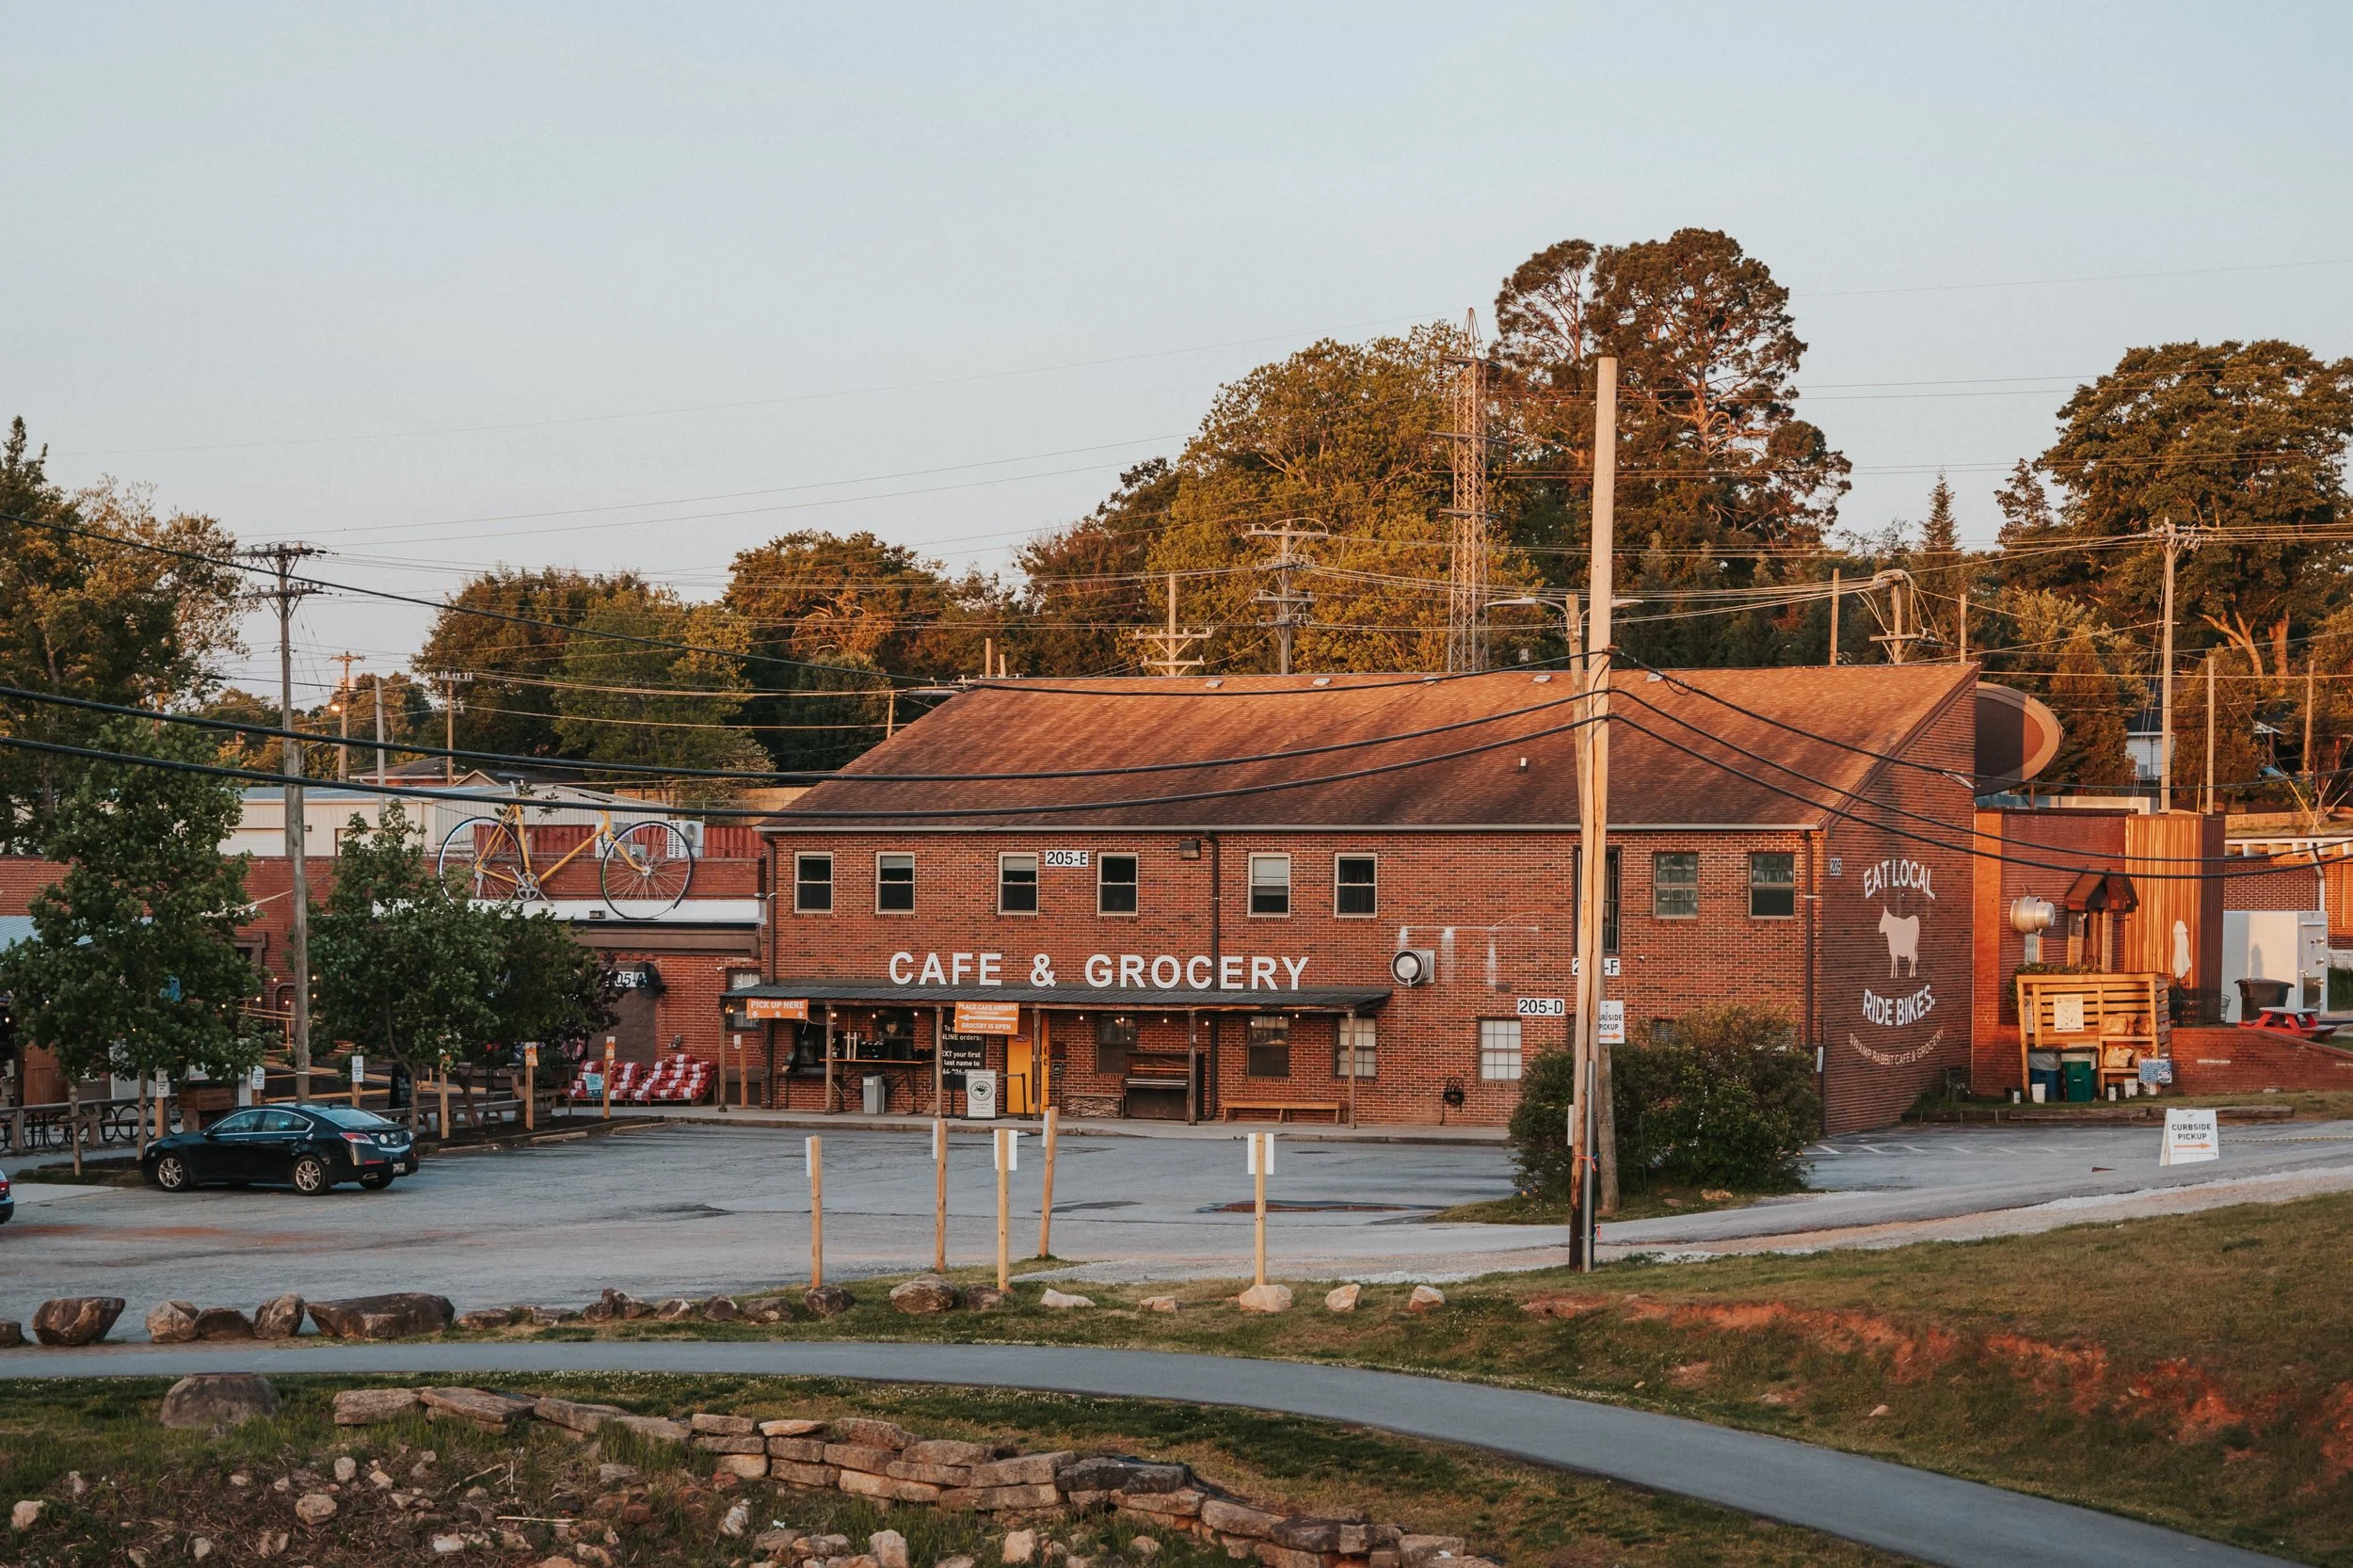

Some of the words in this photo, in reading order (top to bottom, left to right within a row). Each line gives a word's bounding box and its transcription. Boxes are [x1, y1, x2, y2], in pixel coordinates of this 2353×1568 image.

[1047, 851, 1087, 865] 205-E
[1831, 859, 1842, 874] 205
[1864, 860, 1890, 900] EAT
[1892, 858, 1935, 900] LOCAL.
[888, 952, 1002, 986] CAFE
[1030, 952, 1057, 987] &
[1084, 953, 1309, 990] GROCERY
[750, 1000, 769, 1009] PICK
[771, 1000, 782, 1009] UP
[783, 1000, 805, 1010] HERE
[1519, 1000, 1562, 1014] 205-D
[1863, 988, 1894, 1026] RIDE
[1896, 984, 1935, 1026] BIKES.
[1849, 1032, 1872, 1058] SWAMP
[1872, 1050, 1894, 1065] RABBIT
[1895, 1051, 1911, 1065] CAFE
[1912, 1050, 1916, 1062] &
[1916, 1026, 1944, 1058] GROCERY
